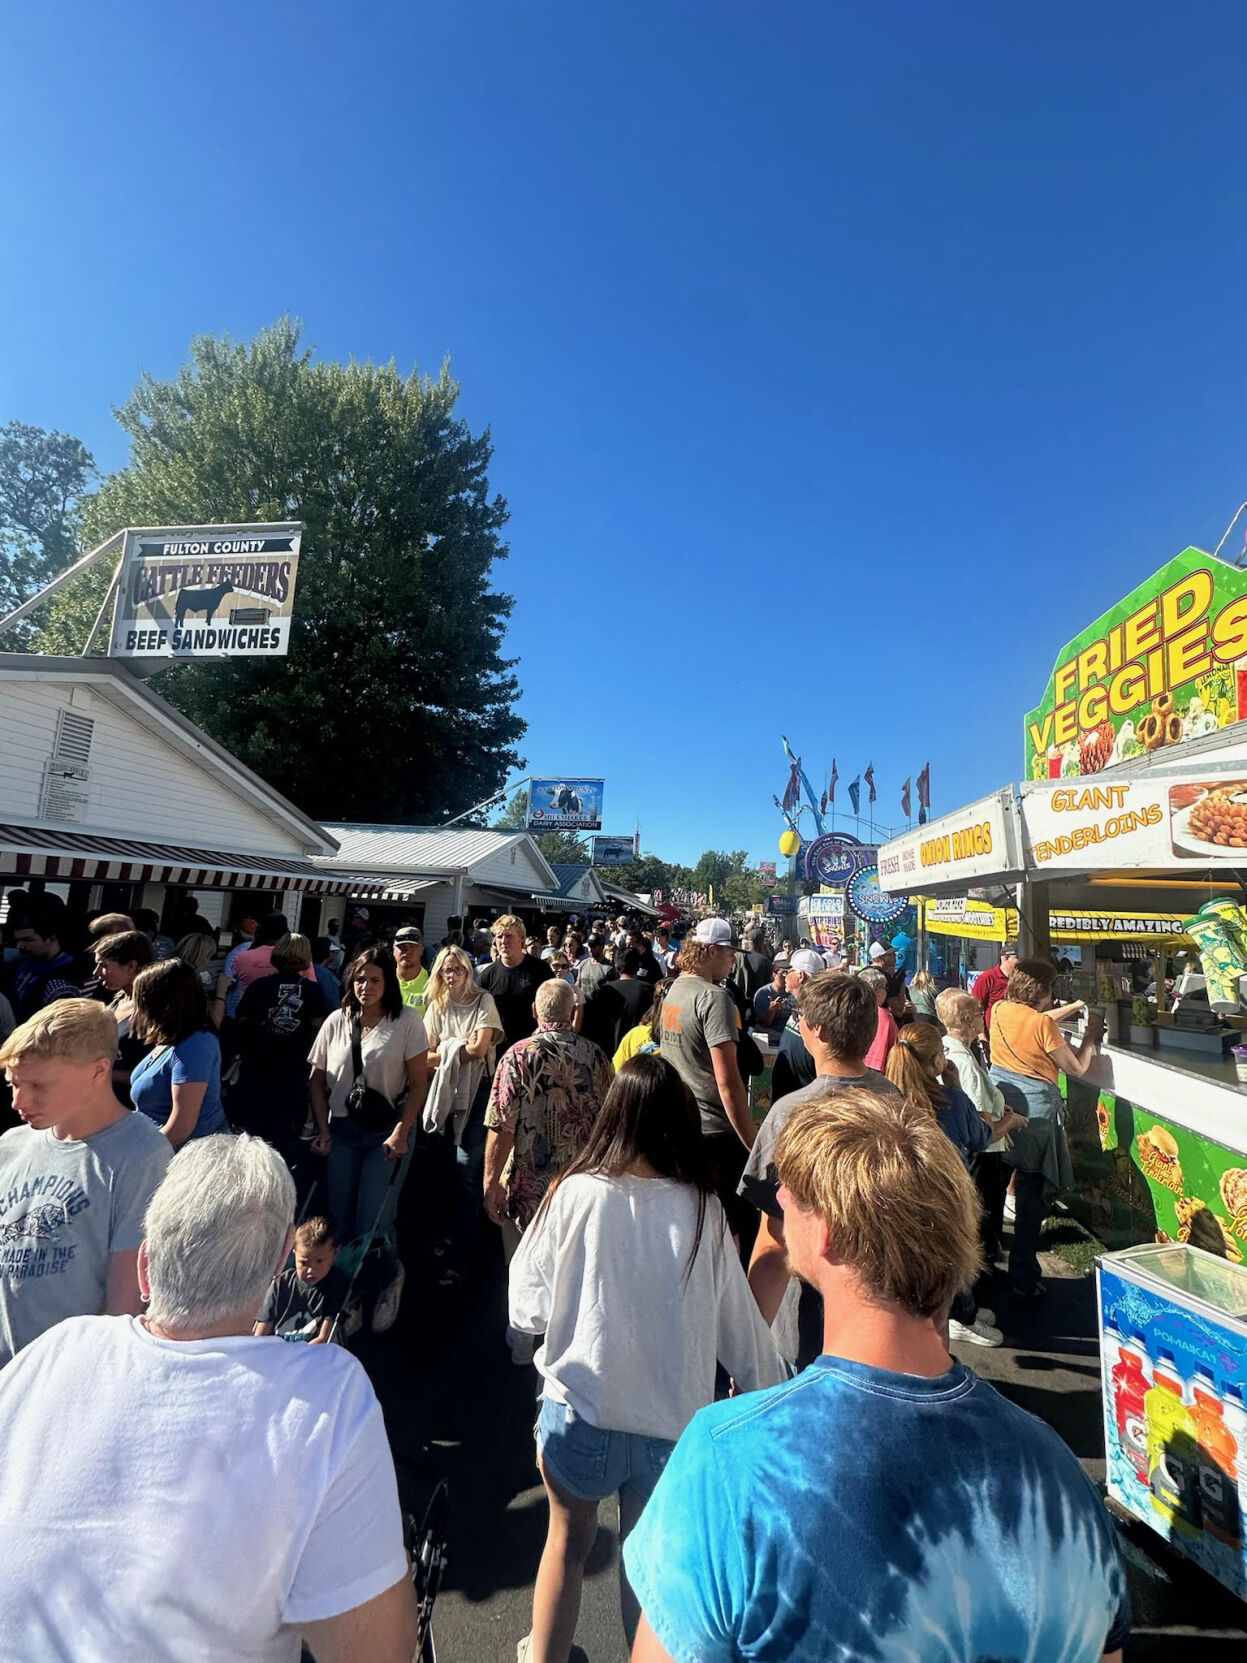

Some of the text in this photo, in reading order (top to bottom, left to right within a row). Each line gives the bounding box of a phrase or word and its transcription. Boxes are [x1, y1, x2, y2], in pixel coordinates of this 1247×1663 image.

[163, 540, 266, 556] FULTON COUNTY
[134, 561, 291, 605] CATTLE FEEDERS
[125, 627, 281, 650] BEEF SANDWICHES
[1054, 568, 1214, 708] FRIED
[1028, 594, 1247, 757] VEGGIES
[1051, 785, 1130, 812] GIANT
[920, 821, 993, 868] ONION RINGS
[880, 855, 900, 876] FRESH
[1113, 918, 1184, 934] AMAZING
[3, 1243, 80, 1263] MADE IN THE
[5, 1258, 69, 1279] PARADISE
[1200, 1464, 1224, 1501] G
